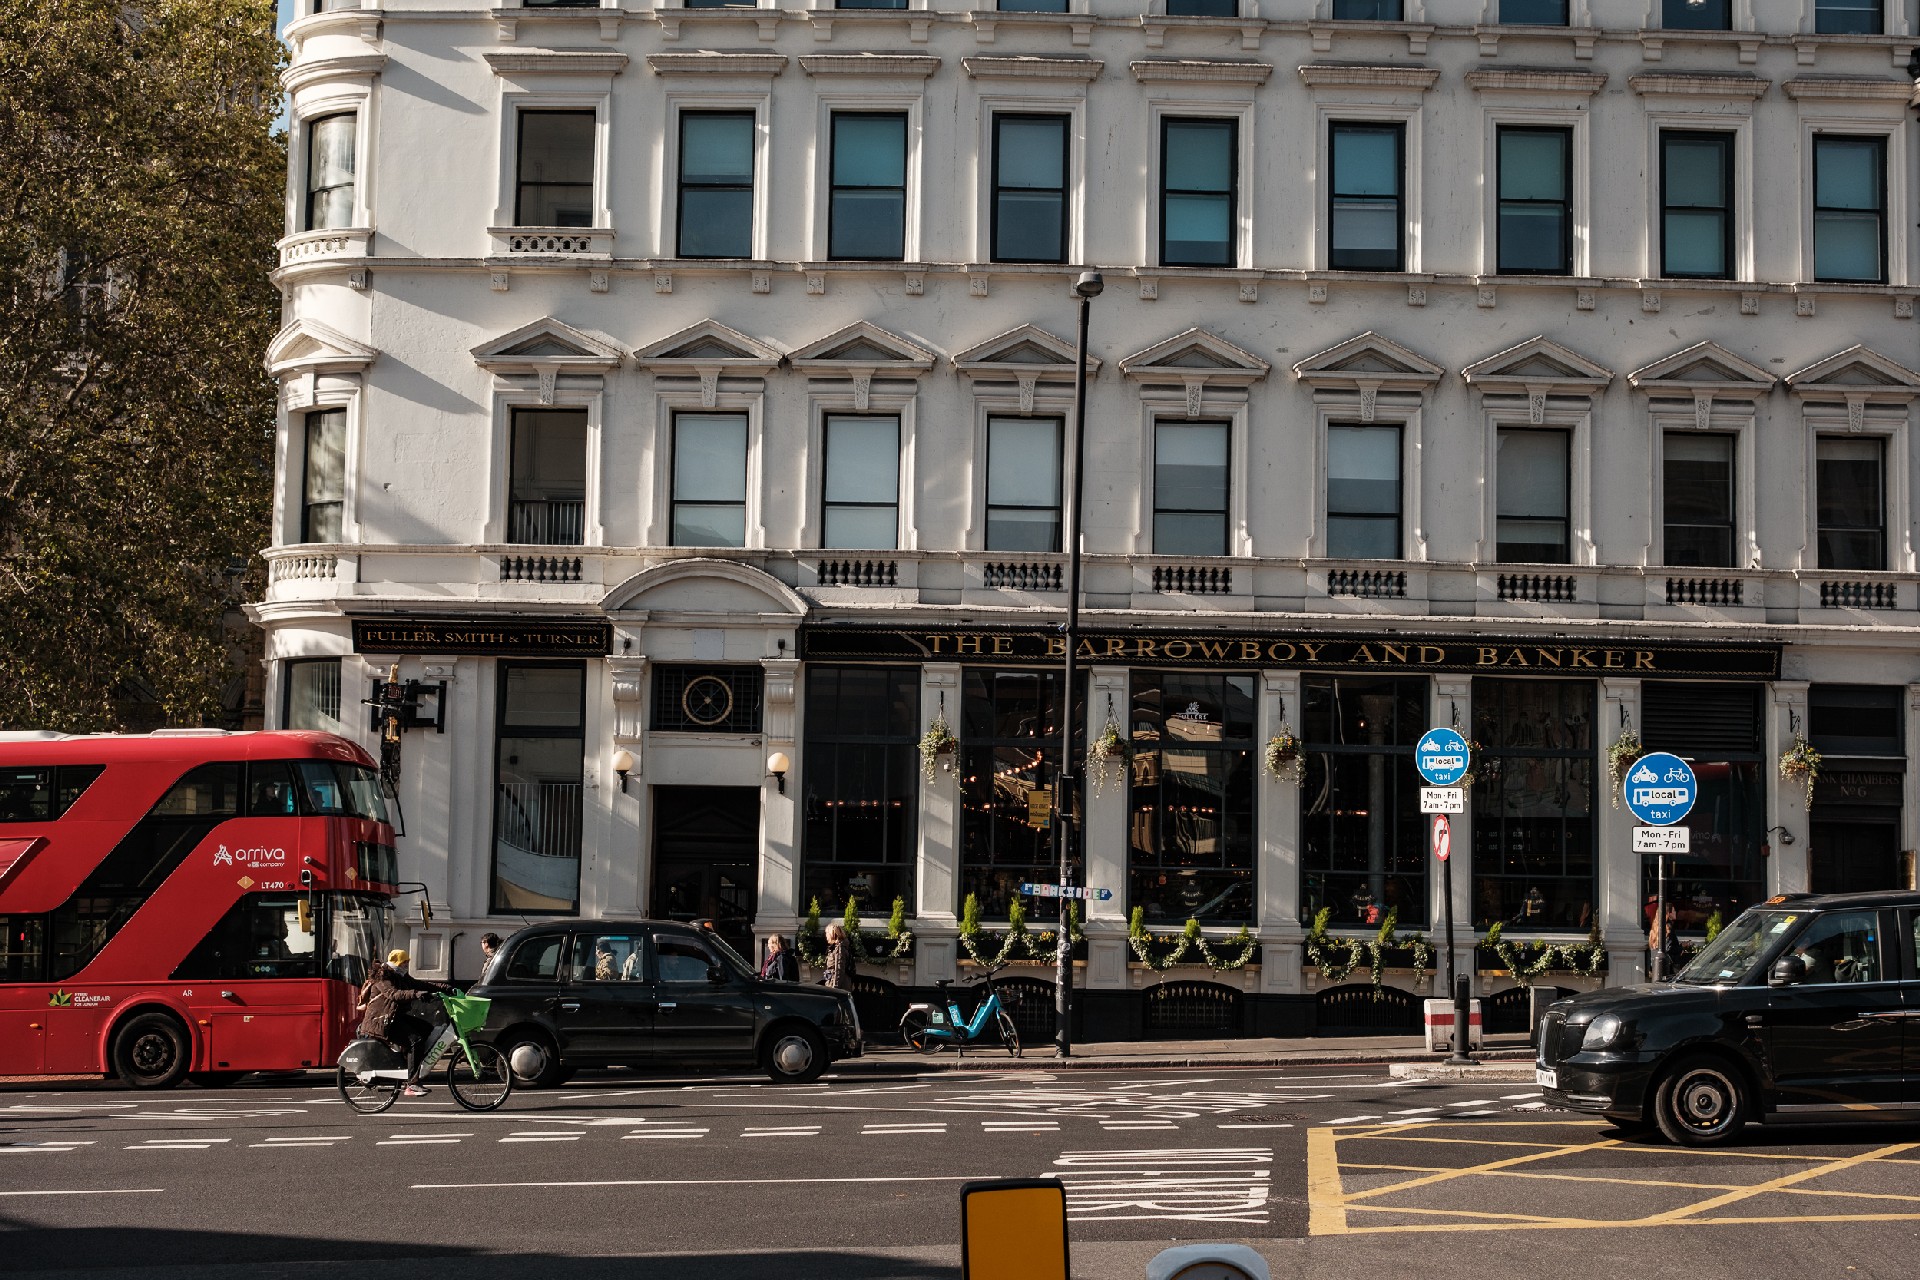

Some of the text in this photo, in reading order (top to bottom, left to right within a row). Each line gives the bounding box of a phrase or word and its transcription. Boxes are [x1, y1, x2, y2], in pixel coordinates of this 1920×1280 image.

[366, 631, 599, 645] FULLER, SMITH & TURNER
[925, 635, 1657, 669] THE BARROWBOY AND BANKER
[1435, 757, 1455, 765] local
[1434, 773, 1451, 781] taxi
[1840, 773, 1900, 785] CHAMBERS
[1426, 791, 1442, 799] Mon
[1447, 791, 1457, 799] Fri
[1651, 790, 1677, 799] local
[1857, 786, 1868, 798] 6
[1650, 810, 1671, 819] taxi
[1641, 830, 1661, 838] Mon
[1668, 830, 1681, 838] Fri
[235, 845, 285, 861] arriva
[261, 881, 284, 889] LT470
[182, 989, 193, 997] AR
